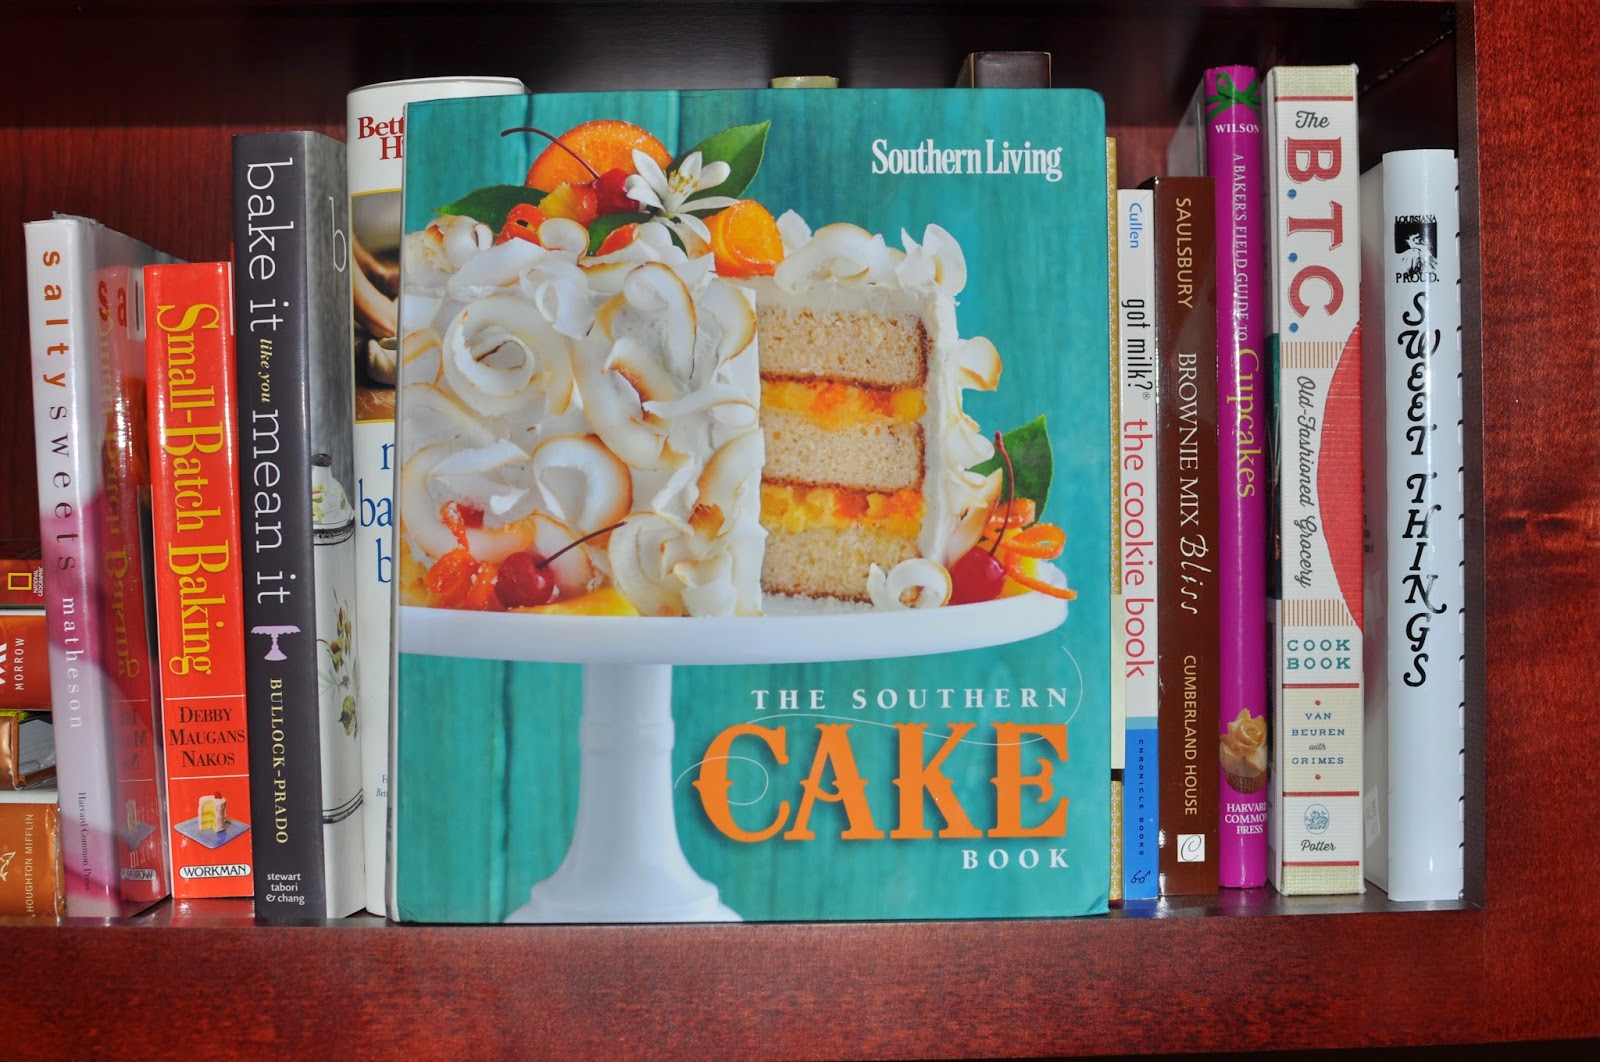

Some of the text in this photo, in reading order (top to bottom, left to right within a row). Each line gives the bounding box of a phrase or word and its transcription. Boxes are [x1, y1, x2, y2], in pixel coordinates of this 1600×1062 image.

[1215, 124, 1259, 134] WILSON
[1295, 110, 1330, 128] The
[872, 138, 1063, 182] Southern Living
[1128, 202, 1143, 249] Cullen
[1395, 214, 1437, 224] LOUISIANA
[1176, 198, 1194, 309] SAULSBURY
[1122, 298, 1150, 328] got
[1227, 153, 1262, 498] A BAKER'S FIELD GUIDE TO Cupcakes
[247, 156, 297, 604] bake it like you mean it
[43, 250, 84, 729] salty sweets matheson
[156, 303, 230, 676] Small-Batch Baking
[1178, 352, 1212, 615] BROWNIE MIX Bliss
[1294, 376, 1318, 589] Old-Fashioned Grocery
[1398, 291, 1448, 688] SWEET THINGS
[1123, 418, 1154, 680] the cookie book
[1286, 638, 1351, 652] COOK
[14, 638, 25, 690] MORROW
[1286, 656, 1351, 671] BOOK
[751, 688, 1069, 710] THE SOUTHERN
[179, 706, 232, 724] DEBBY
[168, 727, 246, 746] MAUGANS
[1184, 654, 1198, 816] CUMBERLAND HOUSE
[1309, 742, 1327, 750] with
[182, 750, 236, 768] NAKOS
[269, 678, 288, 844] BULLOCK-PRADO
[691, 721, 1070, 843] CAKE
[1226, 802, 1267, 812] HARVARD
[78, 792, 92, 891] Harvard Common Press
[1236, 824, 1263, 834] PRESS
[1300, 839, 1336, 852] Potter
[24, 814, 34, 912] HOUGHTON MIFFLIN
[184, 864, 247, 877] WORKMAN
[961, 848, 1070, 870] BOOK
[266, 872, 302, 881] stewart
[270, 882, 298, 892] tabori
[266, 893, 305, 906] & chang
